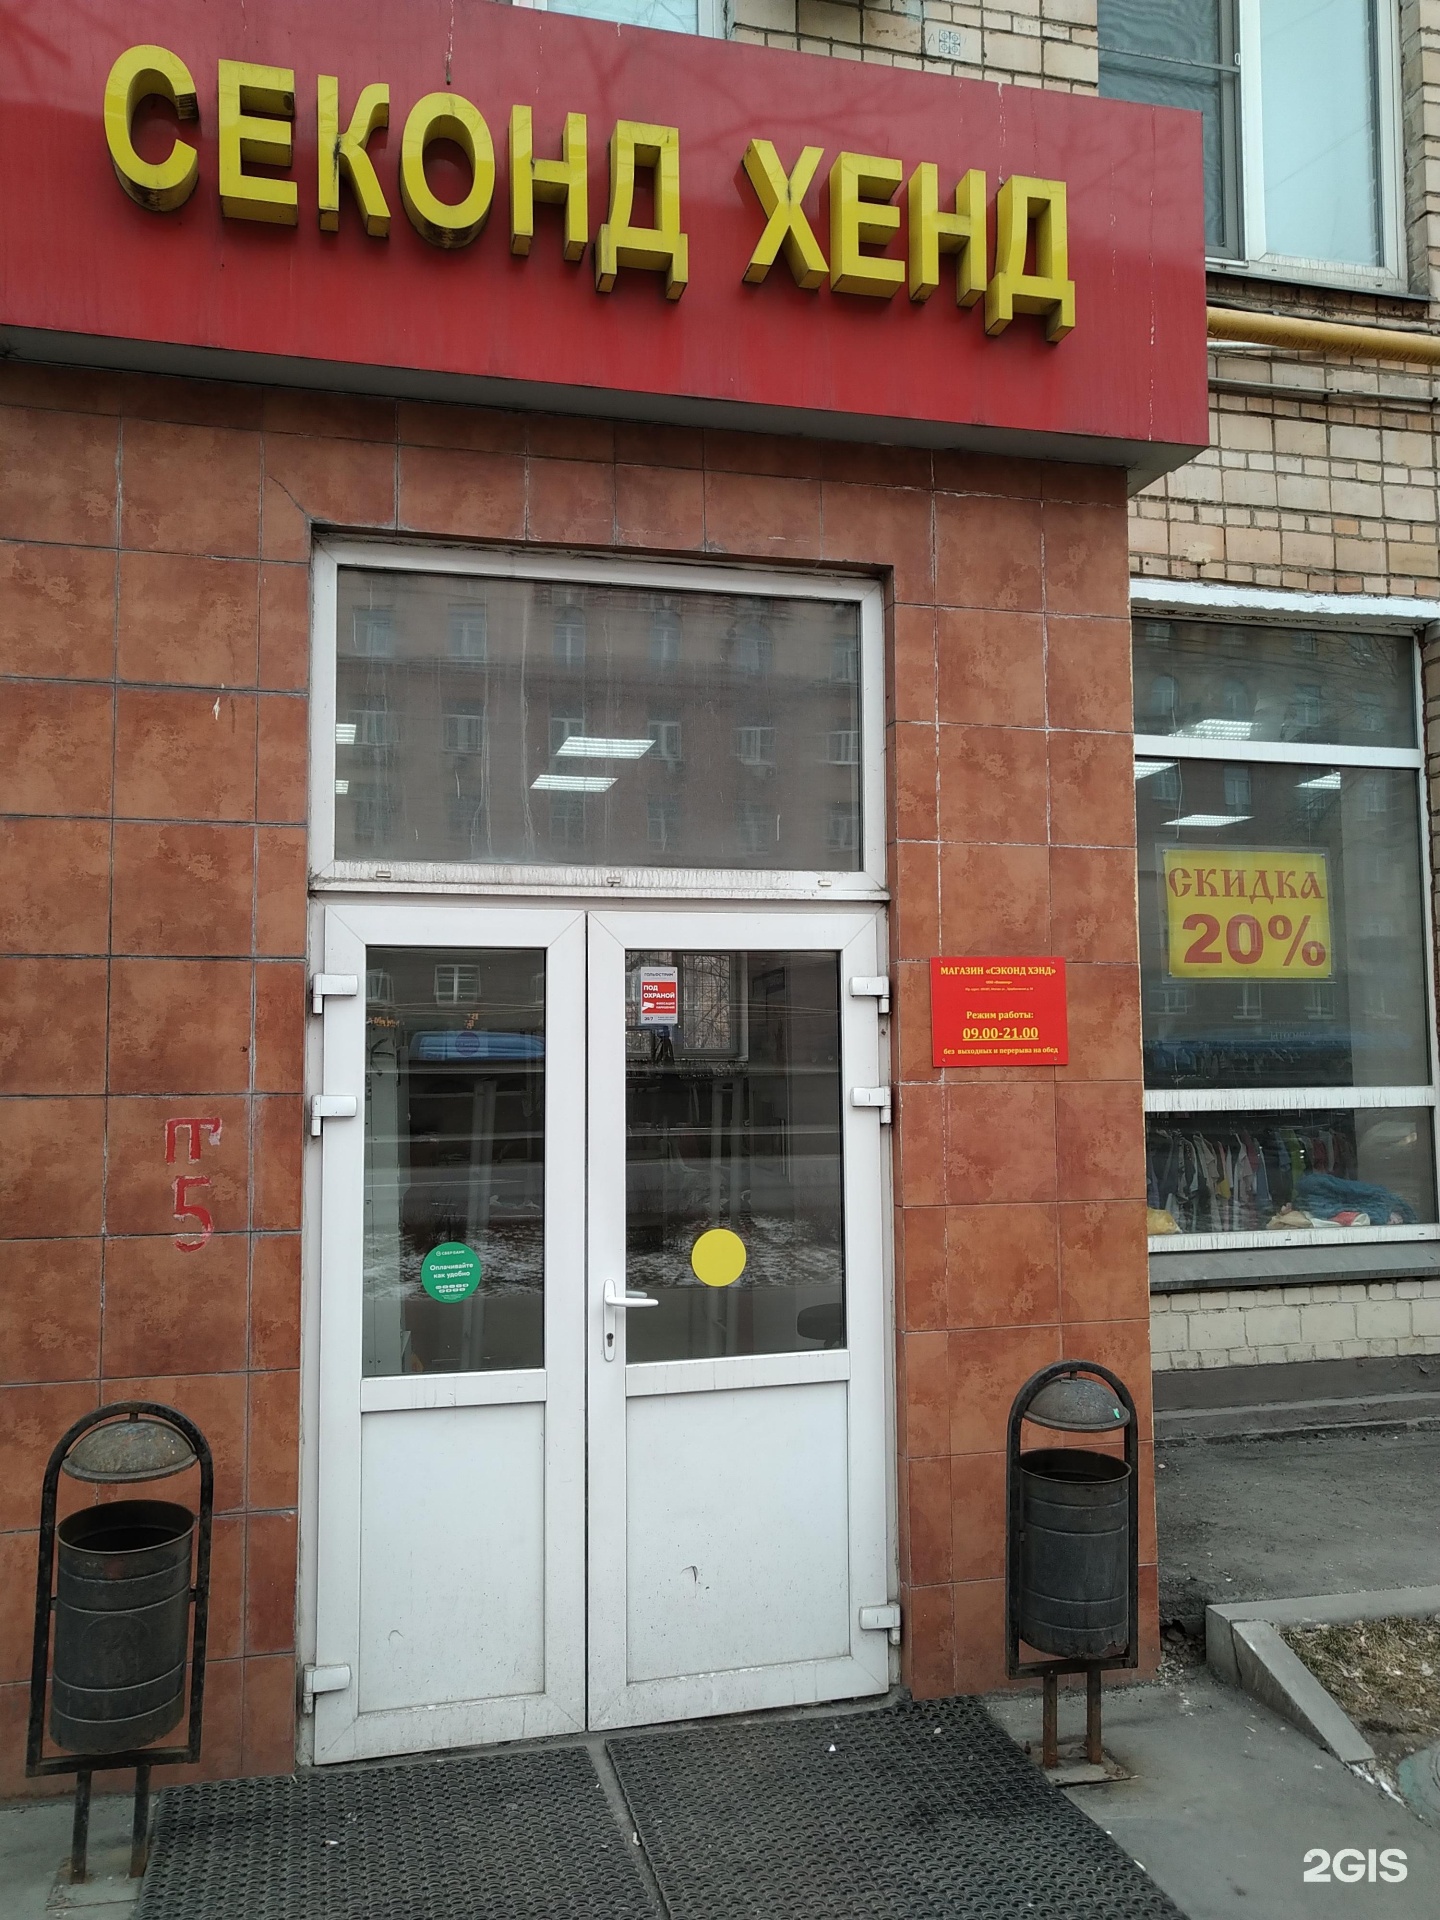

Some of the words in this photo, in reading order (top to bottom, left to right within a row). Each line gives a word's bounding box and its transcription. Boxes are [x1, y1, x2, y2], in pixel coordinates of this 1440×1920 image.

[103, 44, 689, 300] СЕКОНД
[742, 138, 1076, 343] ХЕНД
[1168, 867, 1325, 904] СКИДКА
[1182, 913, 1327, 966] 20%
[940, 966, 984, 975] МАГАЗИН
[986, 966, 1027, 977] «СЭКОНД
[1028, 966, 1057, 976] ХЭНД»
[966, 1011, 997, 1020] Режим
[998, 1011, 1034, 1021] работы:
[962, 1027, 1039, 1041] 09.00-21.00
[957, 1048, 992, 1056] выходных
[1042, 1046, 1058, 1054] обед
[430, 1263, 474, 1271] Оплачивайте
[447, 1270, 471, 1279] удобно
